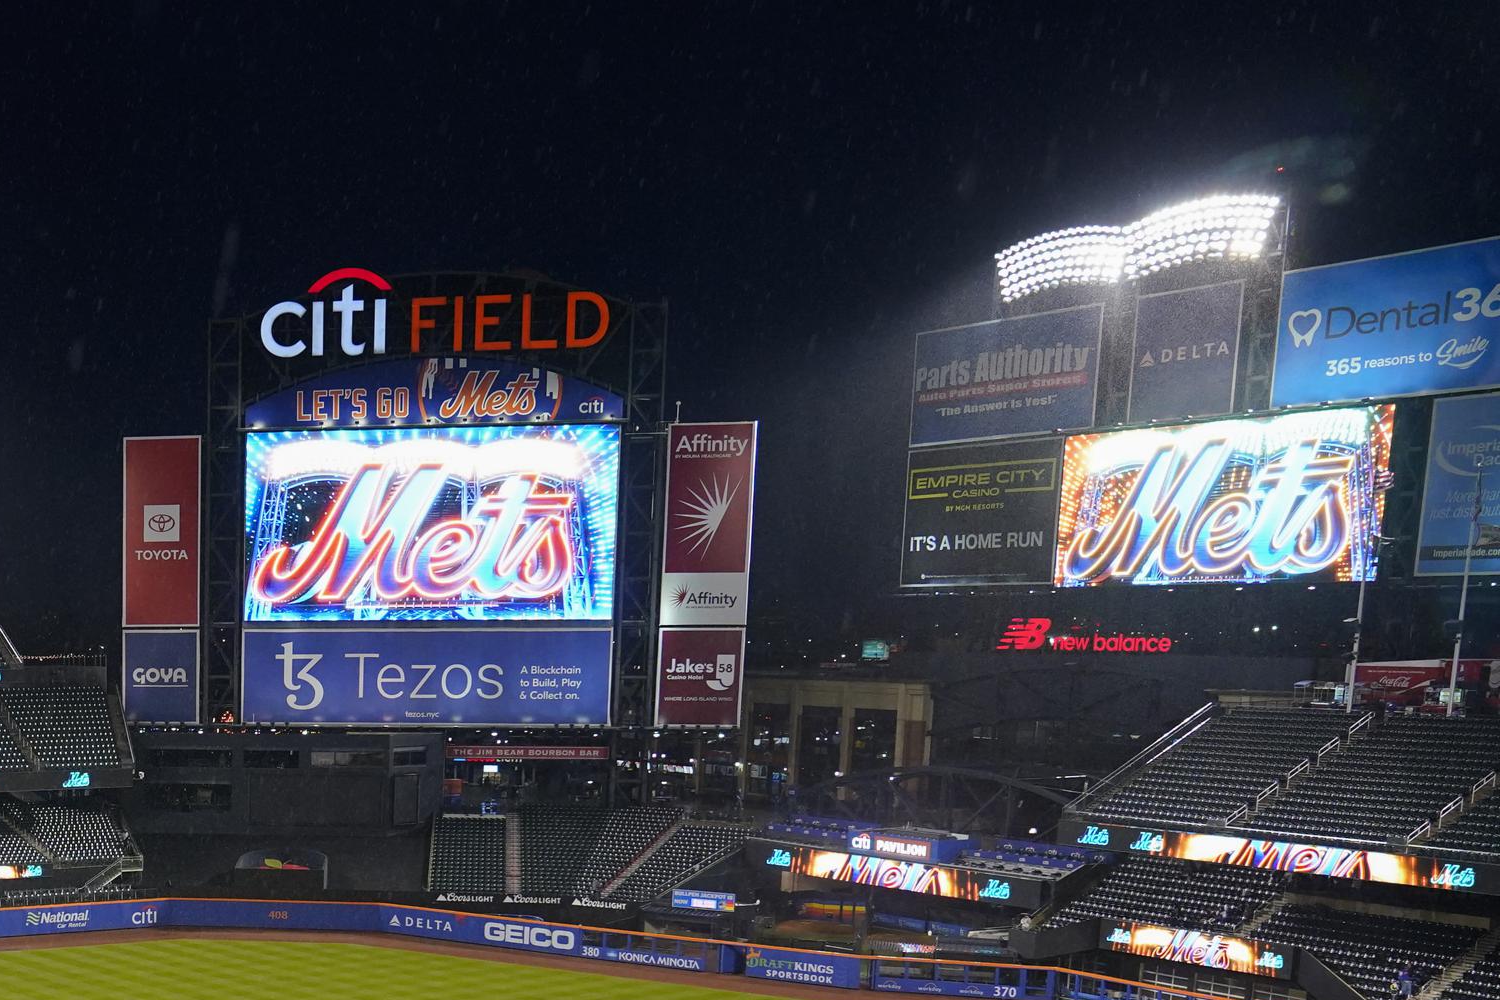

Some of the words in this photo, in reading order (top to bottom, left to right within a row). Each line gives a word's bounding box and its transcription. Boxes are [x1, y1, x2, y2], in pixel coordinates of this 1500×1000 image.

[260, 283, 387, 358] citi
[411, 291, 610, 353] FIELD
[1161, 341, 1229, 363] DELTA
[1326, 356, 1362, 377] 365
[1364, 352, 1415, 370] reasons
[1418, 350, 1433, 363] to
[1435, 335, 1490, 366] Smile
[916, 358, 971, 392] Parts
[975, 342, 1089, 383] Authority
[296, 388, 368, 422] LET'S
[376, 386, 410, 419] GO
[440, 367, 538, 418] Mets
[919, 392, 947, 402] Auto
[950, 387, 984, 399] Parts
[987, 381, 1029, 393] Super
[1032, 375, 1082, 388] Stores
[579, 399, 604, 414] citi
[964, 402, 1010, 414] Answer
[675, 433, 748, 456] Affinity
[916, 473, 990, 489] EMPIRE
[996, 469, 1045, 484] CITY
[952, 487, 999, 498] CASINO
[973, 502, 1004, 510] RESORTS
[1068, 439, 1354, 579] Mets
[252, 463, 575, 603] Mets
[910, 536, 936, 551] IT'S
[940, 535, 950, 550] A
[954, 533, 1002, 550] HOME
[1007, 531, 1043, 548] RUN
[135, 549, 189, 561] TOYOTA
[687, 591, 738, 608] Affinity
[1053, 636, 1089, 651] new
[1093, 634, 1172, 653] balance
[520, 666, 528, 675] A
[531, 665, 582, 675] Blockchain
[666, 658, 714, 674] Jake's
[717, 663, 733, 673] 58
[132, 667, 189, 684] GOYA
[345, 653, 504, 700] Tezos
[520, 679, 530, 687] to
[532, 678, 560, 689] Build,
[562, 678, 582, 690] Play
[519, 692, 528, 701] &
[530, 691, 562, 701] Collect
[564, 693, 580, 701] on.
[405, 711, 440, 719] tezos.nyc
[876, 839, 927, 857] PAVILION
[1430, 863, 1476, 888] Mets
[447, 892, 470, 903] Coors
[472, 895, 493, 903] LIGHT
[514, 894, 537, 905] Coors
[538, 896, 561, 904] LIGHT
[582, 897, 604, 908] Coors
[605, 901, 627, 910] LIGHT
[40, 910, 89, 924] National
[132, 908, 157, 925] citi
[268, 910, 289, 920] 408
[405, 916, 453, 932] DELTA
[484, 921, 575, 950] GEICO
[582, 946, 600, 958] 380
[1154, 929, 1231, 971] Mets
[619, 951, 656, 965] KONICA
[657, 956, 700, 970] MINOLTA
[765, 969, 832, 984] SPORTSBOOK
[877, 982, 902, 991] workday
[918, 985, 942, 993] workday
[959, 988, 984, 996] workday
[993, 986, 1017, 998] 370
